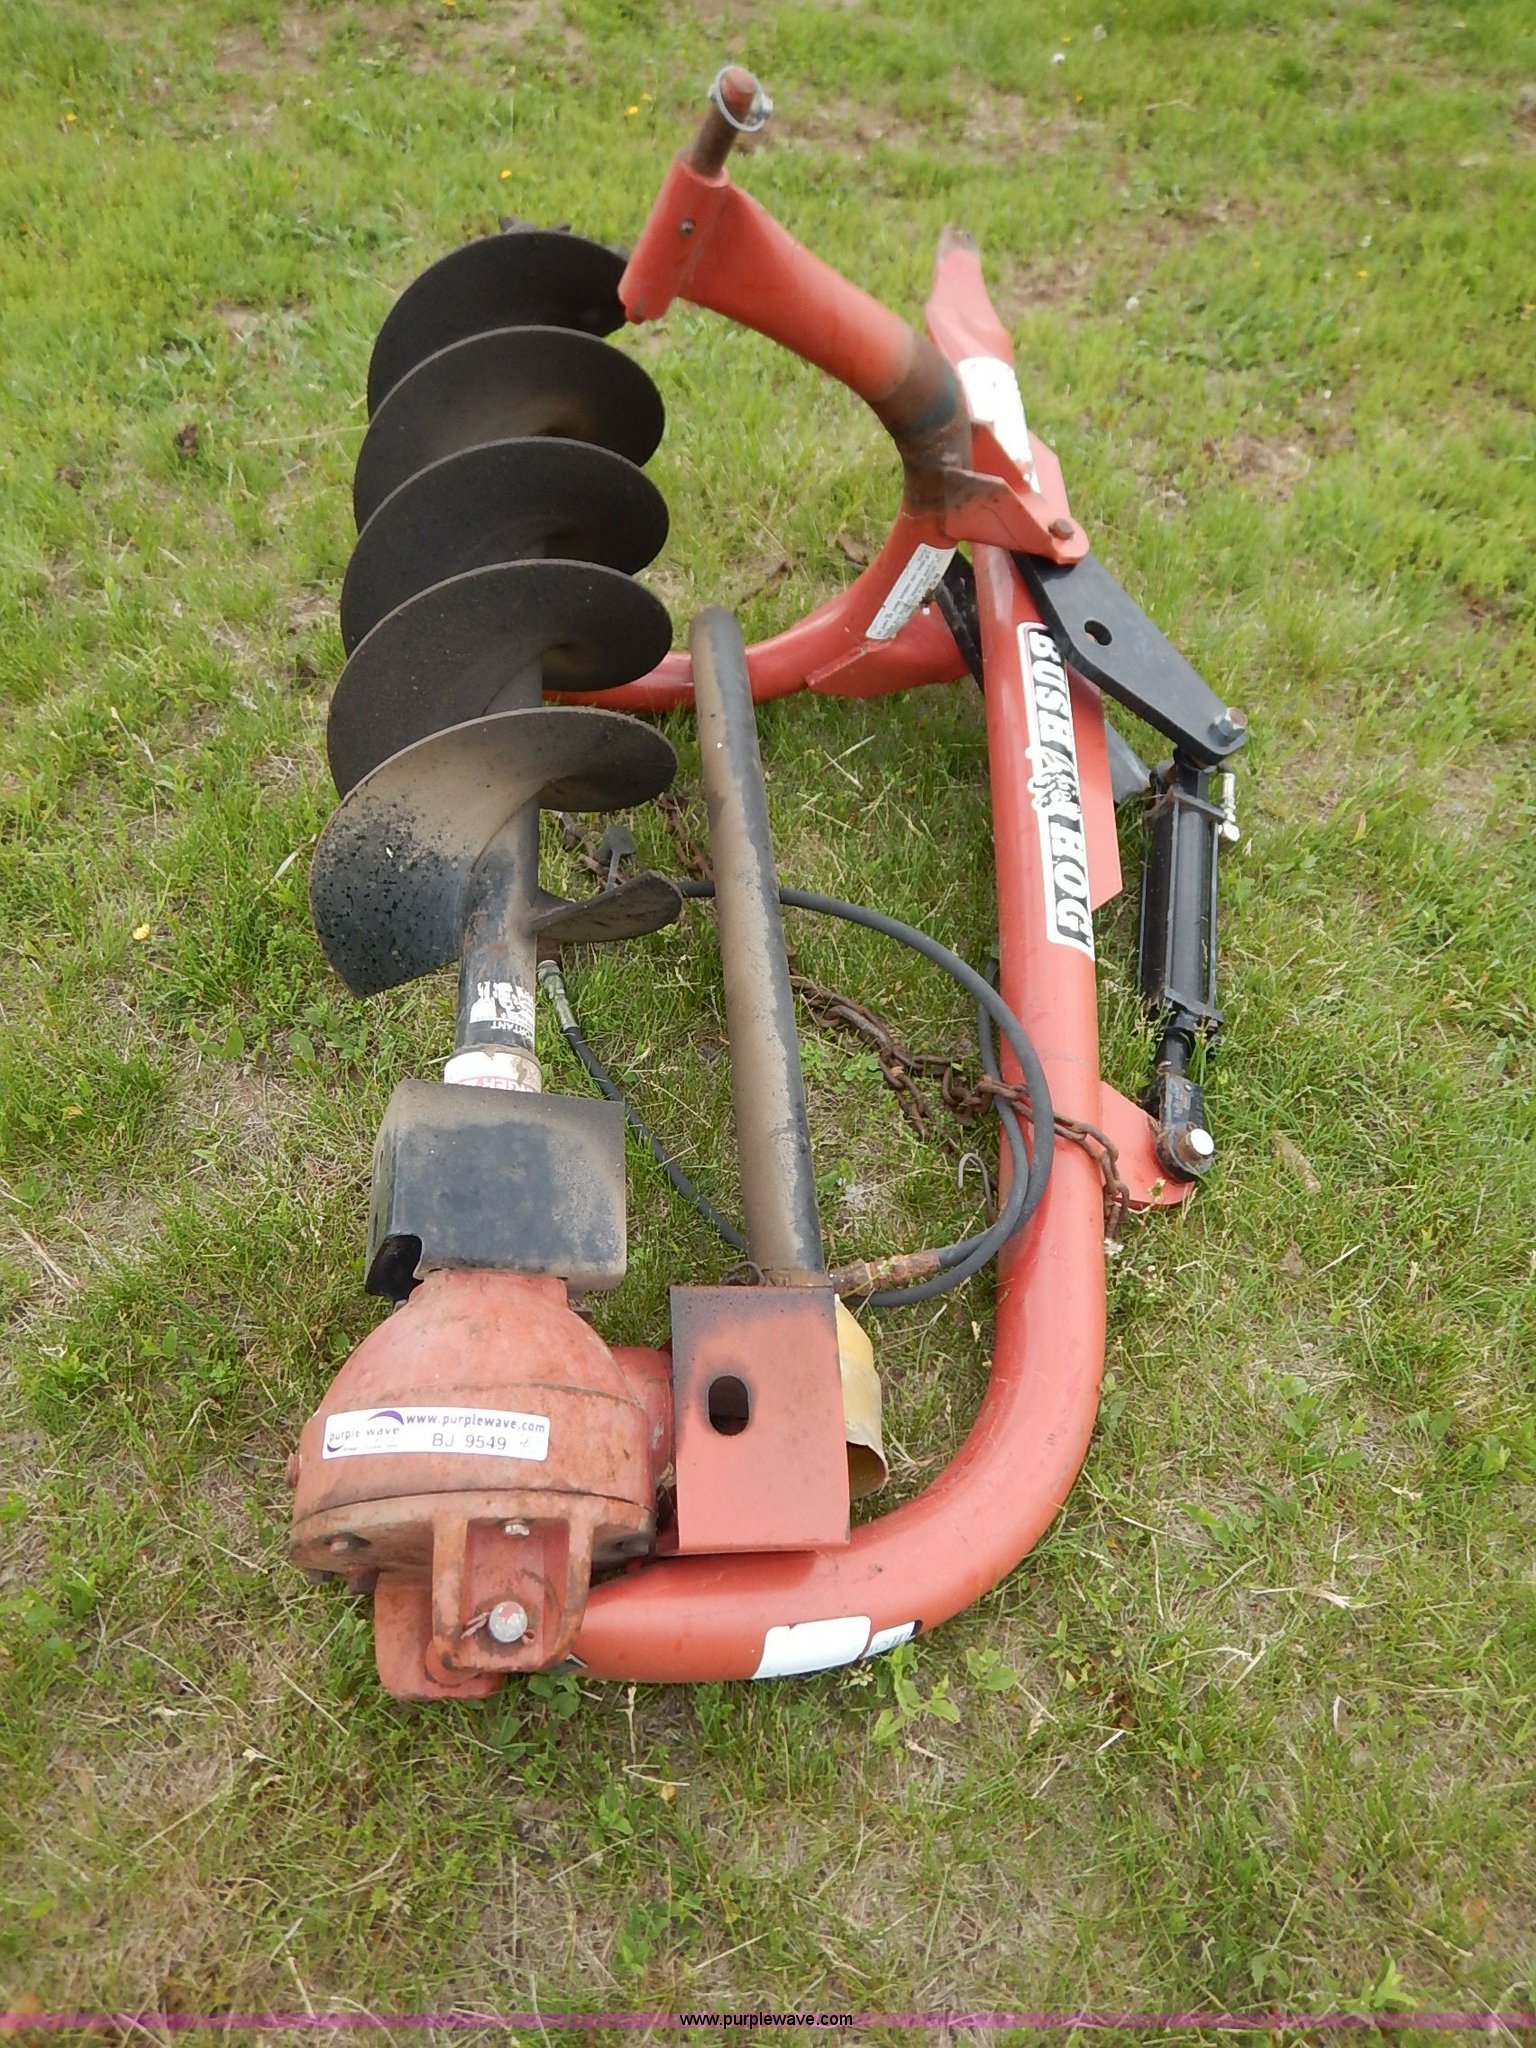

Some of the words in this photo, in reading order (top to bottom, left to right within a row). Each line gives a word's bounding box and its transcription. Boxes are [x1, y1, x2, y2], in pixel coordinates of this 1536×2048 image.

[1028, 630, 1072, 752] BUSH
[1050, 820, 1091, 944] HOG
[405, 1413, 546, 1433] www.purplewave.com
[432, 1432, 455, 1448] BJ
[465, 1434, 507, 1451] 9549
